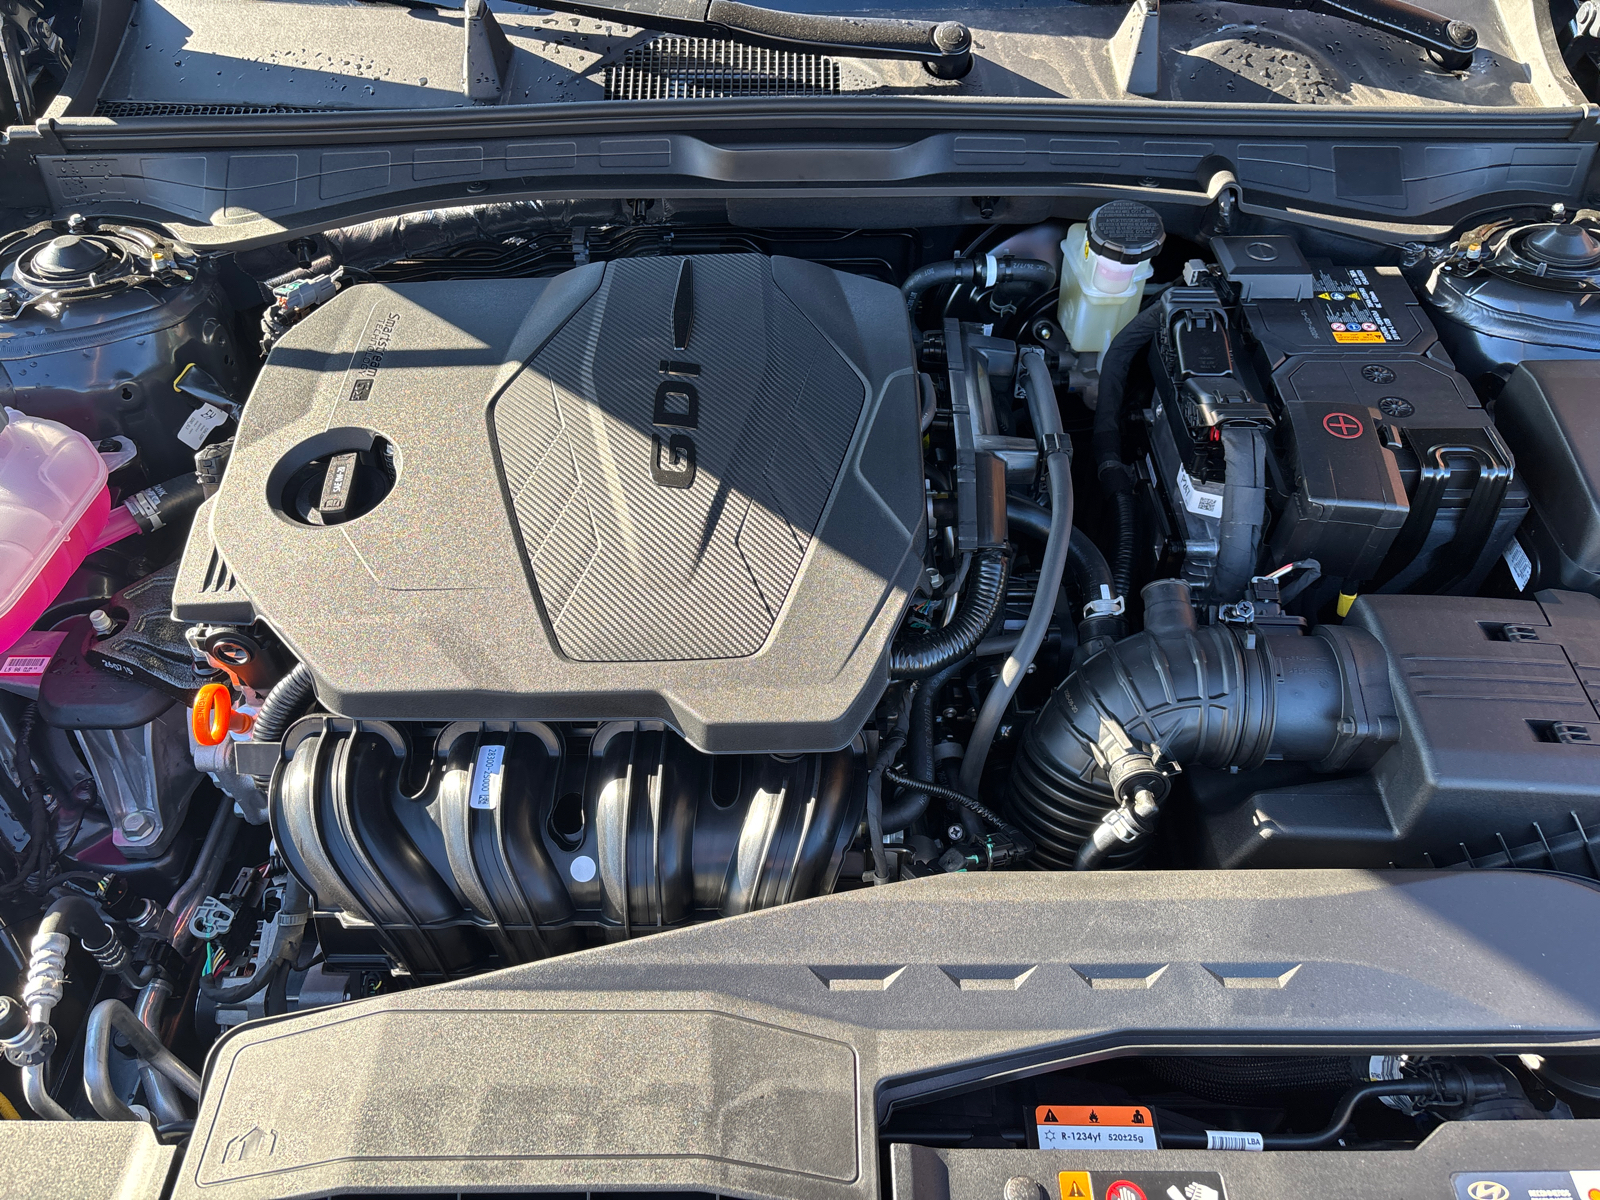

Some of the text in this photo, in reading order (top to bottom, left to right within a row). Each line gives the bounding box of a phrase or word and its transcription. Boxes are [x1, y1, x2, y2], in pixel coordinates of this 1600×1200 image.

[358, 319, 386, 377] TECHNOLOGY
[366, 312, 401, 377] Smartstream
[650, 360, 701, 489] GDi
[332, 482, 343, 492] SAE
[481, 748, 497, 792] 28300-2S000
[1061, 1132, 1144, 1143] R-1234yf 520±25g
